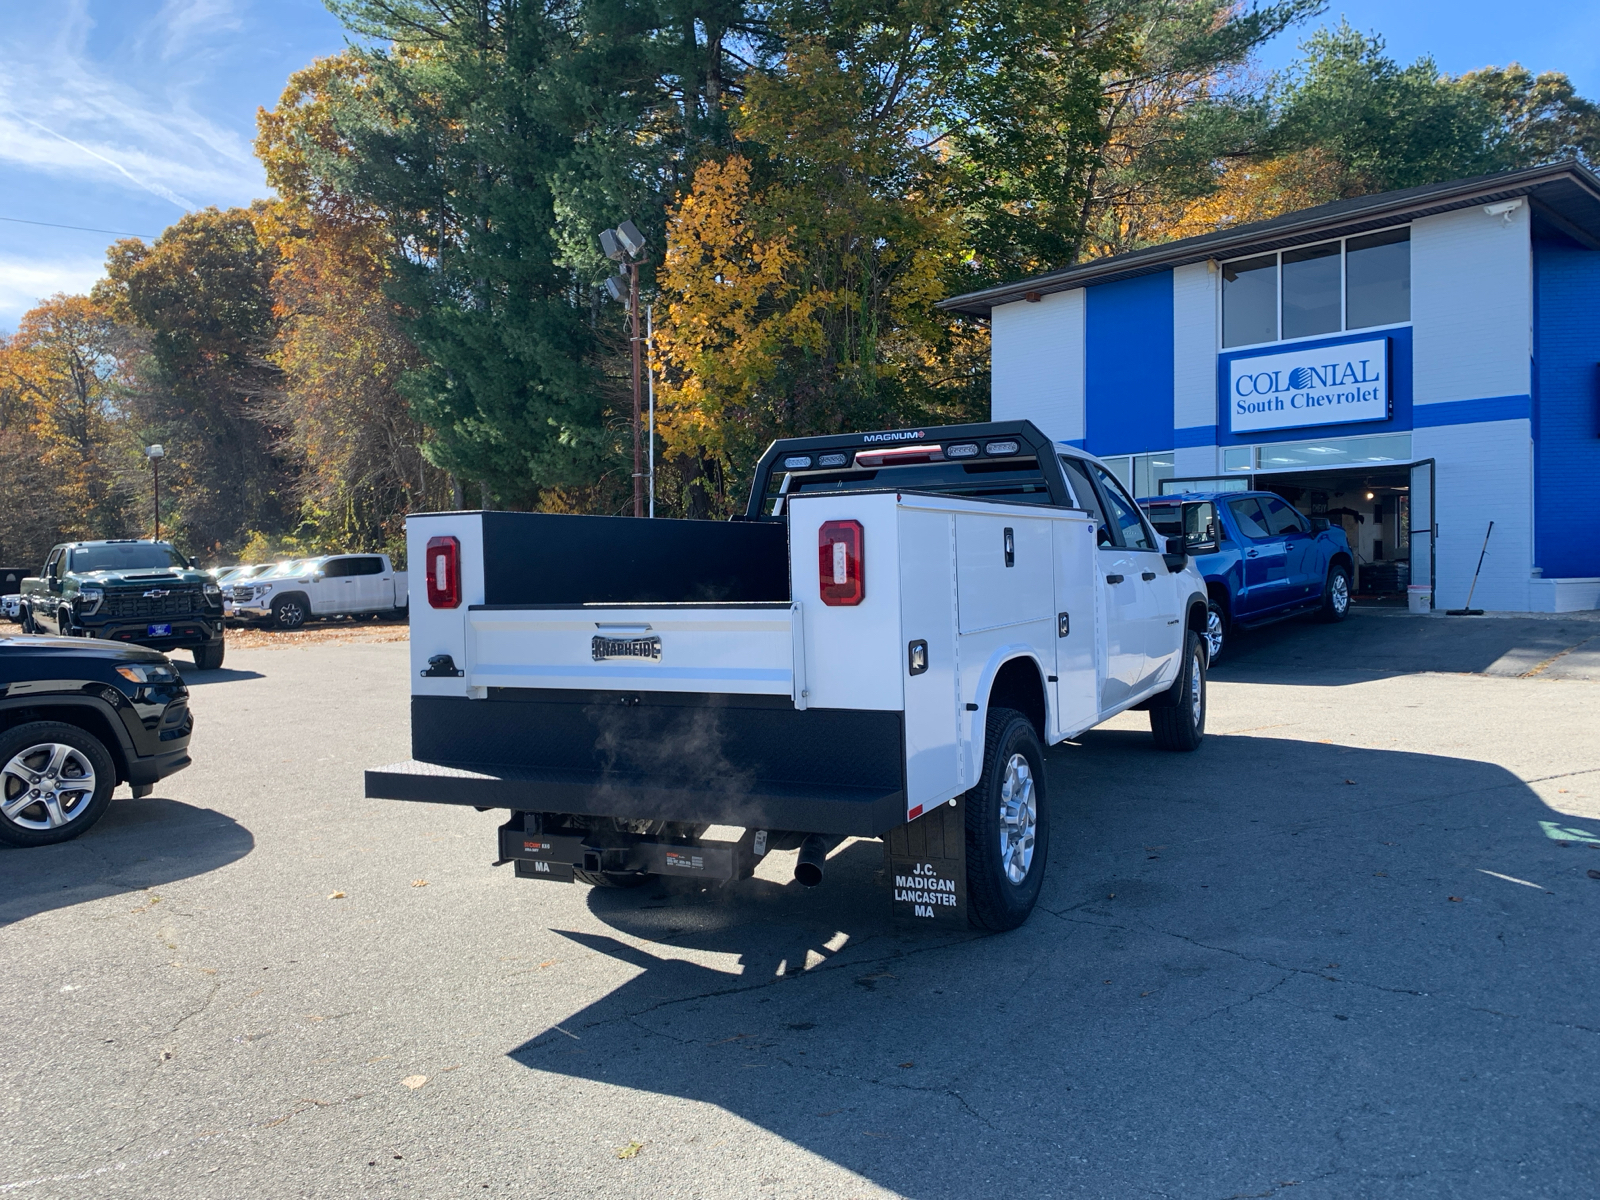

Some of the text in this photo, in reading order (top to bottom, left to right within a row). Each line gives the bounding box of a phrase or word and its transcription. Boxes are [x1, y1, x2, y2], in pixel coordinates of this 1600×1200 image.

[1236, 386, 1380, 415] South Chevrolet
[864, 432, 918, 442] MAGNUM
[594, 639, 658, 659] KNAPHEIDE
[535, 861, 550, 872] MA
[913, 863, 936, 875] J.C.
[895, 875, 955, 892] MADIGAN
[895, 889, 957, 906] LANCASTER
[915, 905, 934, 917] MA
